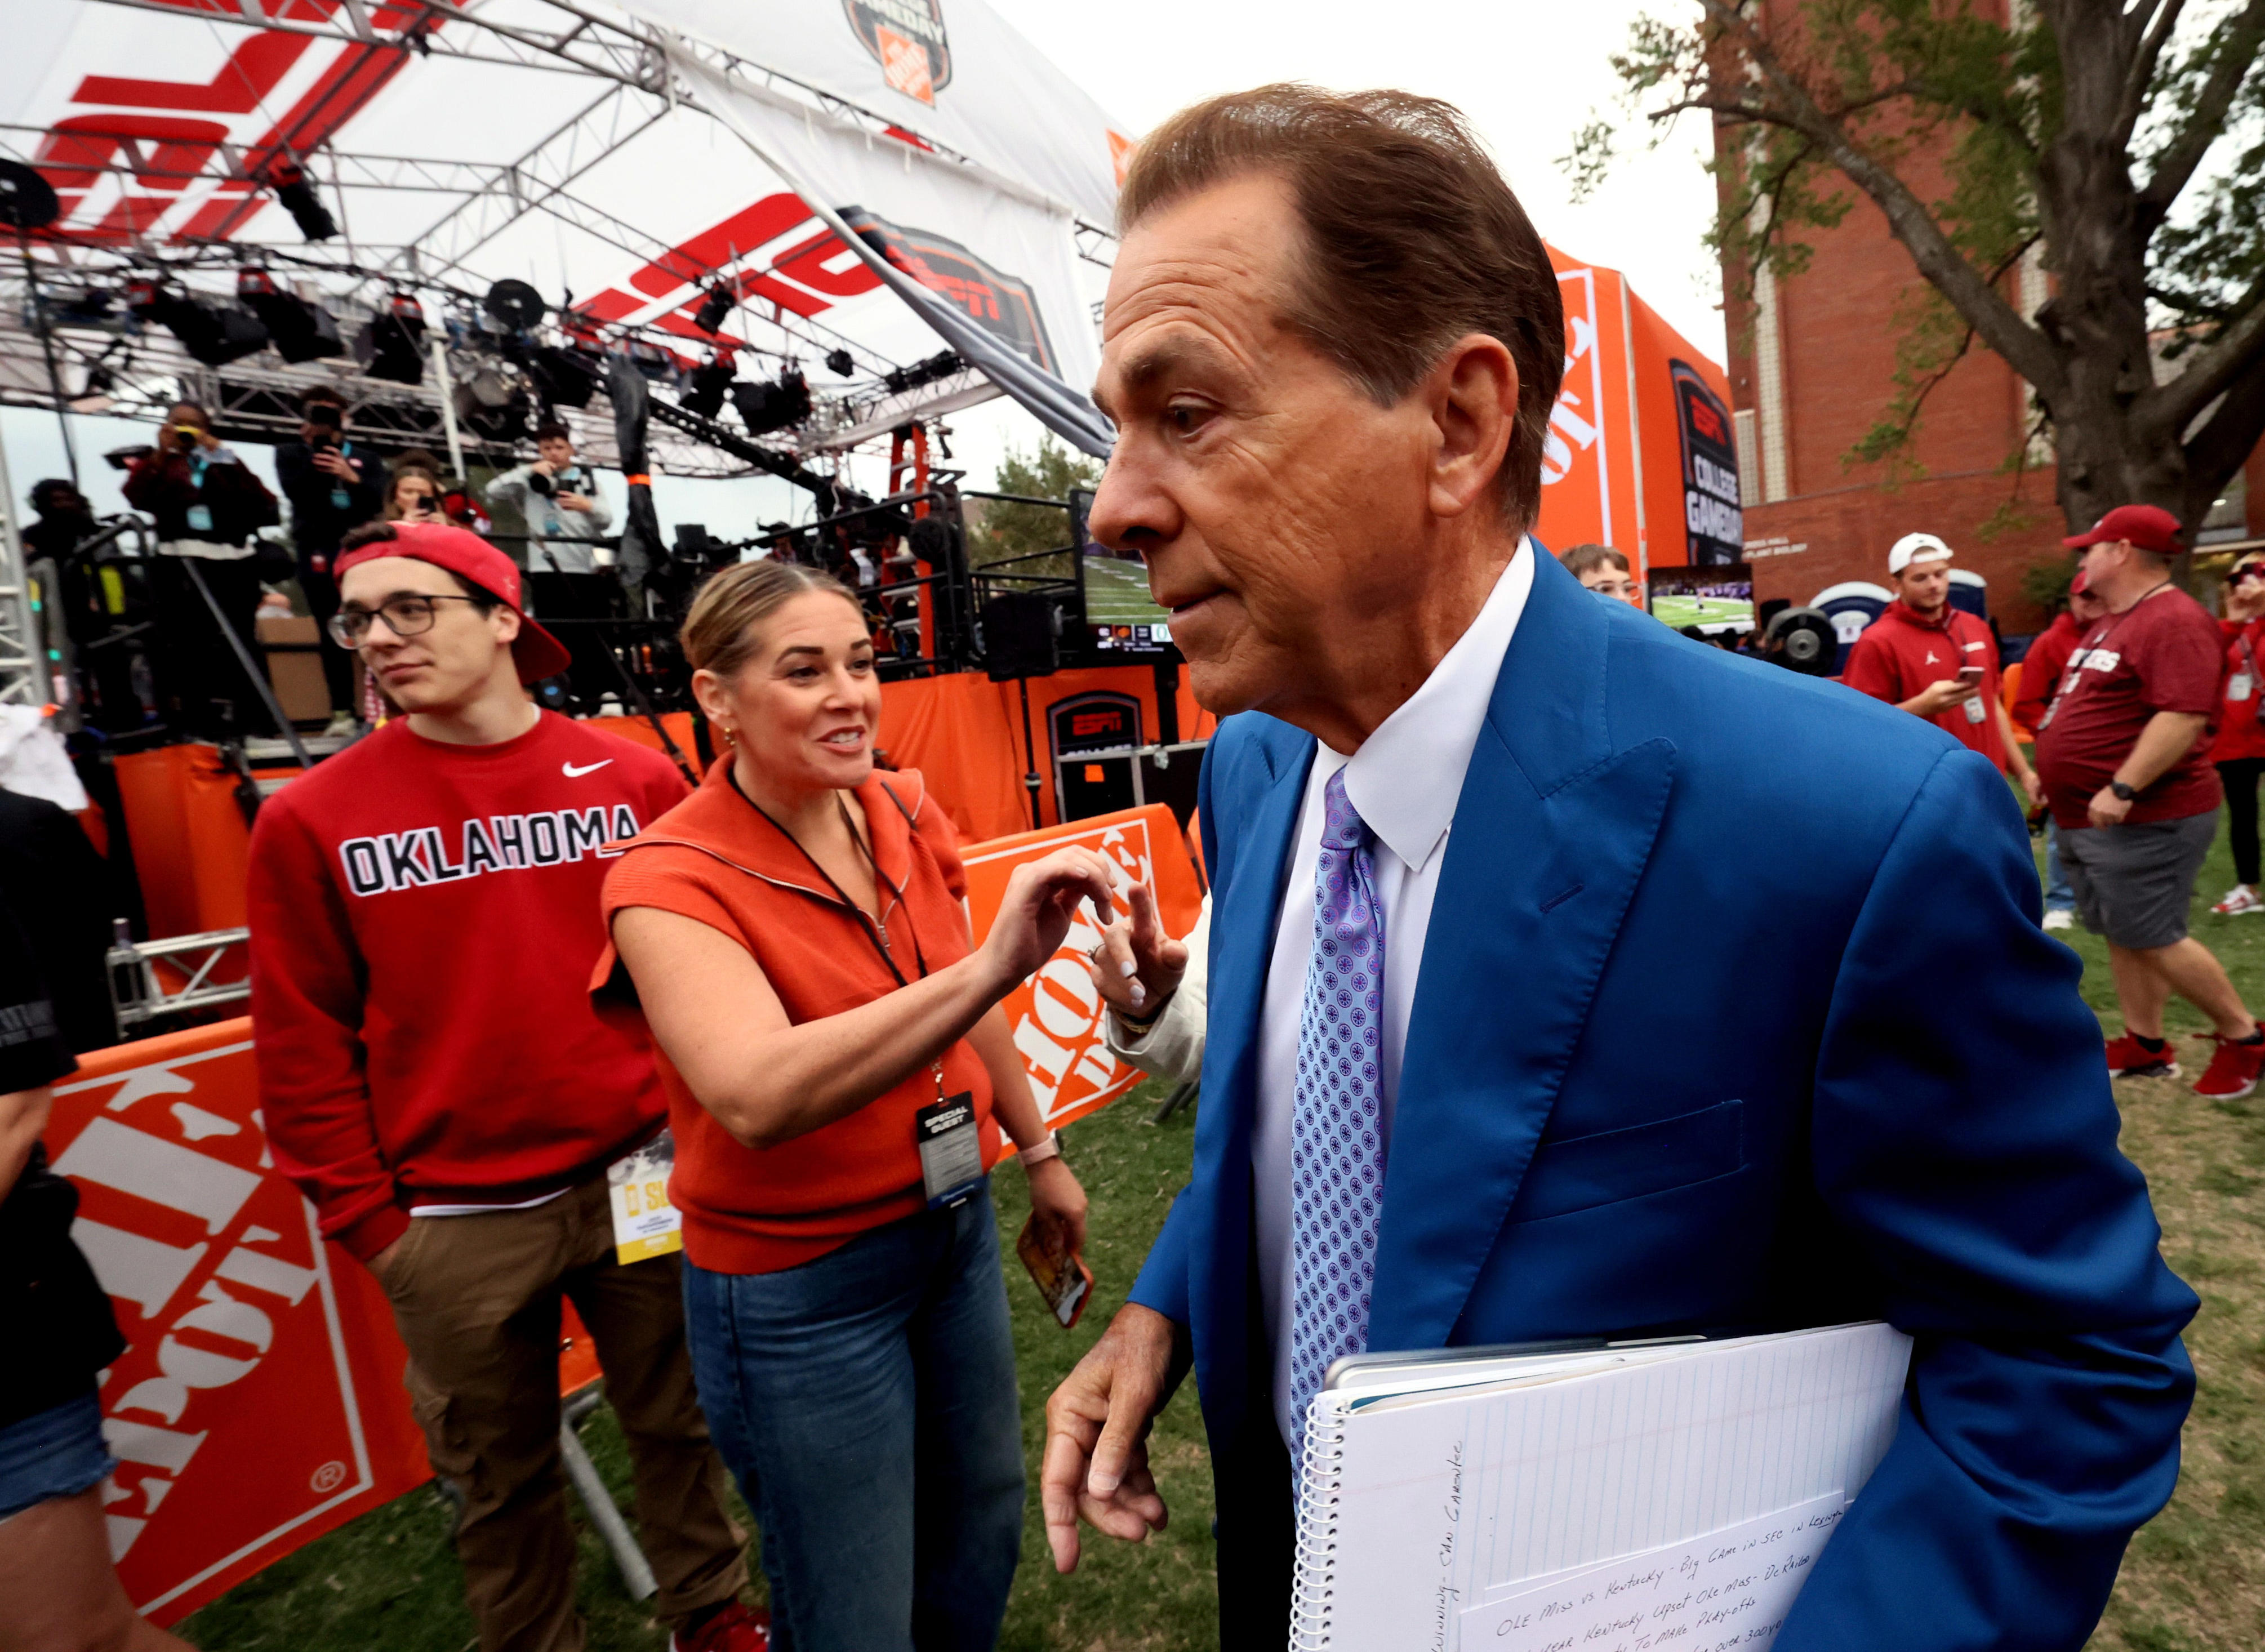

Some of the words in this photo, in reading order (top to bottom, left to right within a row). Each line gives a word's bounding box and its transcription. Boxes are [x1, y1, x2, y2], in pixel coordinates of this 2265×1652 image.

[1694, 453, 1739, 506] COLLEGE
[1073, 711, 1122, 736] ESPN
[339, 804, 641, 897] OKLAHOMA
[924, 1106, 969, 1128] SPECIAL
[1761, 1530, 1783, 1544] SEC
